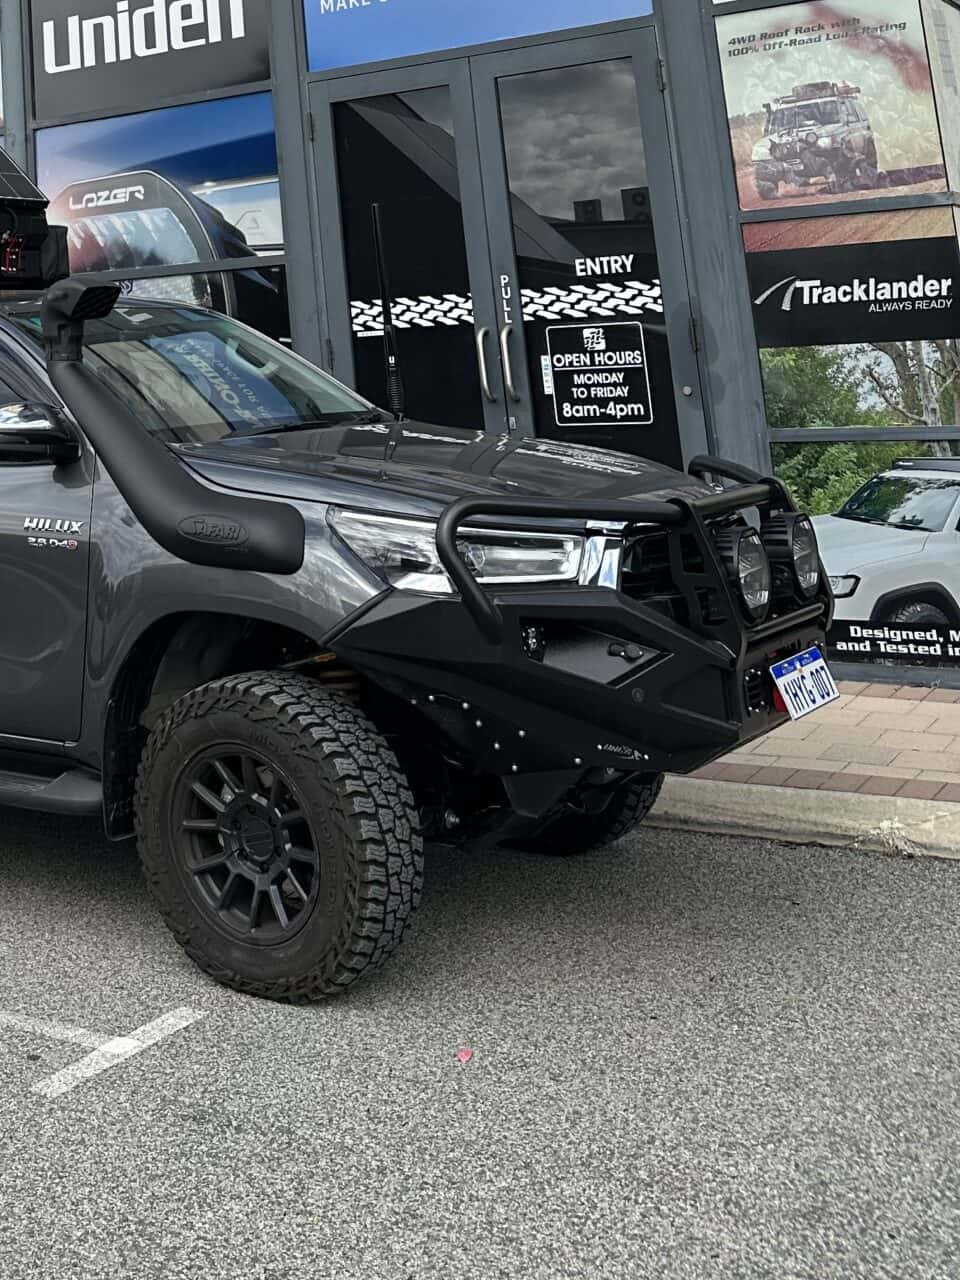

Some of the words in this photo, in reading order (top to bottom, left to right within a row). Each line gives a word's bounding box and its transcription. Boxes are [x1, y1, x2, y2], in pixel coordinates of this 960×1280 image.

[728, 35, 756, 46] 4WD
[760, 29, 789, 41] Roof
[795, 23, 825, 35] Rack
[728, 46, 759, 58] 100%
[862, 22, 907, 36] Rating
[574, 254, 634, 277] ENTRY
[796, 274, 952, 305] Tracklander
[500, 275, 512, 324] PULL
[868, 301, 913, 313] ALWAYS
[915, 299, 953, 310] READY
[552, 353, 591, 367] OPEN
[594, 350, 642, 365] HOURS
[573, 372, 624, 385] MONDAY
[571, 387, 588, 399] TO
[590, 386, 629, 398] FRIDAY
[562, 401, 645, 419] 8am-4pm
[23, 517, 83, 535] HILUX
[849, 625, 944, 643] Designed,
[836, 640, 871, 652] and
[876, 641, 942, 655] Tested
